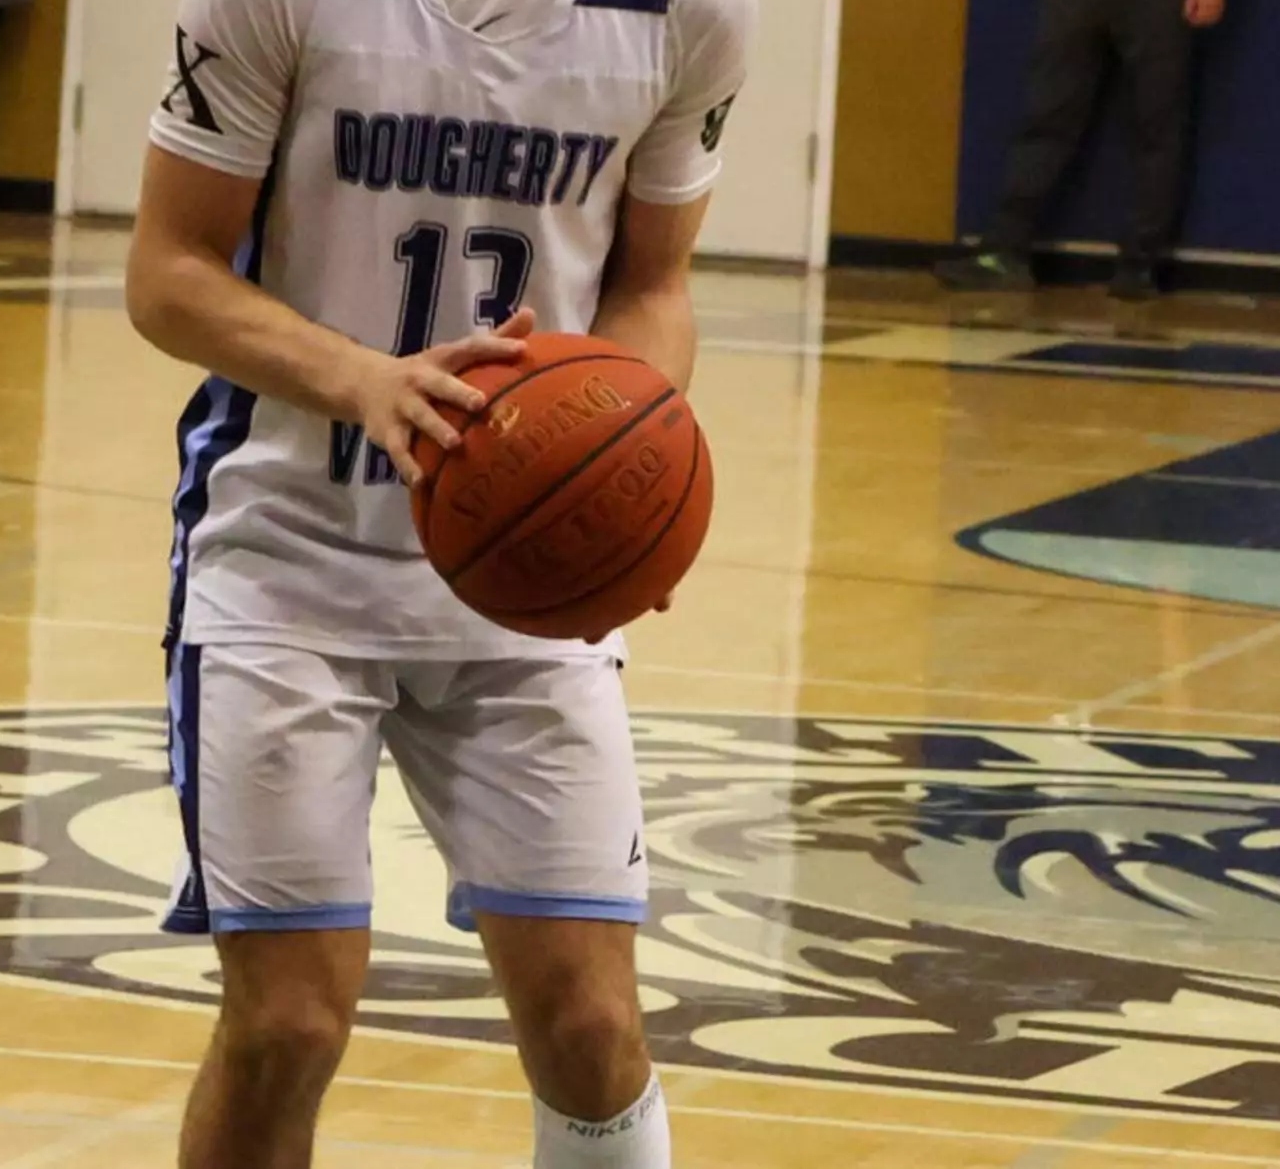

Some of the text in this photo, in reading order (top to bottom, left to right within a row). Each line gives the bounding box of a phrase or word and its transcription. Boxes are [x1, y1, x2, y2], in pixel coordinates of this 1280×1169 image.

[334, 108, 619, 208] DOUGHERTY
[393, 220, 534, 353] 13
[565, 1112, 635, 1139] NIKE
